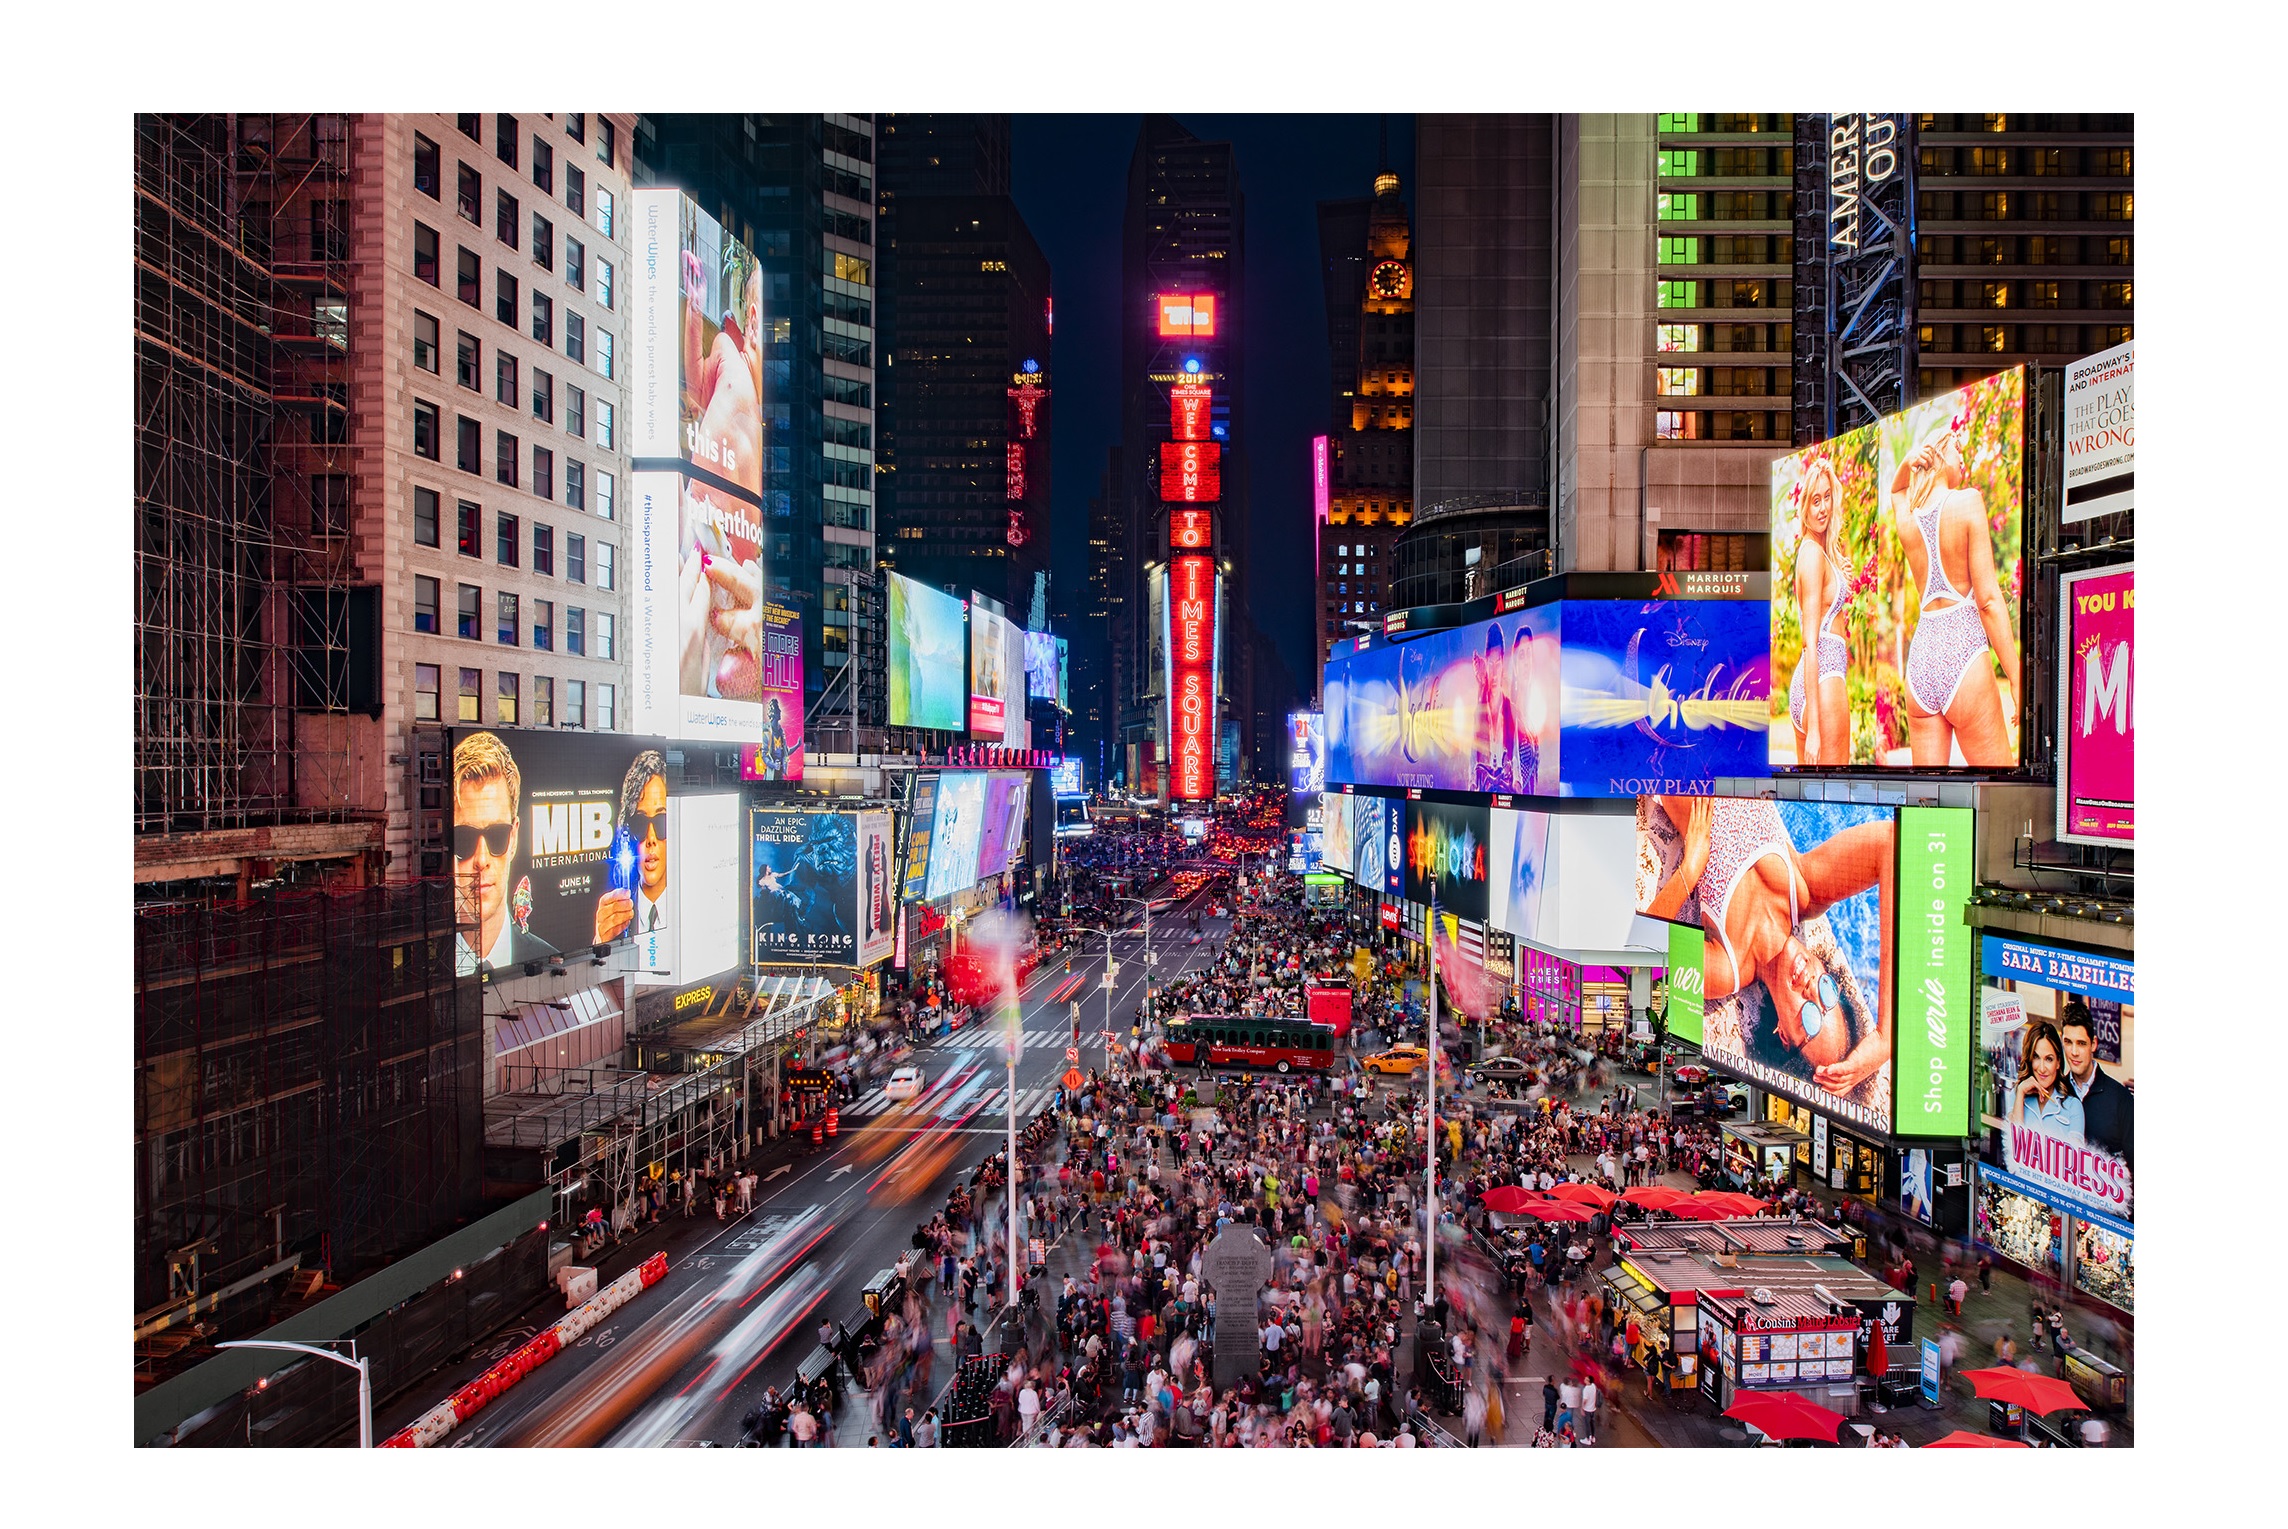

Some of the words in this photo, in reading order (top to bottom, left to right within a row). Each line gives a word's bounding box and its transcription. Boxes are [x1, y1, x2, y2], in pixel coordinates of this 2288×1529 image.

[2073, 353, 2131, 381] BROADWAY'S
[2069, 380, 2087, 394] AND
[2074, 402, 2095, 418] THE
[2097, 386, 2132, 412] PLAY
[2069, 417, 2096, 436] THAT
[686, 422, 719, 463] this
[722, 440, 737, 471] is
[1183, 399, 1199, 501] WELCOME
[1183, 511, 1199, 545] TO
[642, 494, 653, 592] #thisisparenthood
[1687, 574, 1749, 583] MARRIOTT
[1687, 584, 1741, 594] MARQUIS
[1182, 561, 1202, 660] TIMES
[2077, 591, 2116, 615] YOU
[768, 632, 799, 656] MORE
[1663, 630, 1710, 651] Disney
[763, 653, 799, 690] HILL
[1182, 675, 1201, 795] SQUARE
[947, 746, 984, 766] 1540
[1609, 778, 1660, 794] NOW
[1664, 779, 1715, 795] PLAY
[532, 802, 614, 857] MIB
[756, 834, 781, 842] THRILL
[761, 826, 797, 834] DAZZLING
[1928, 832, 1947, 853] 3!
[532, 850, 614, 869] INTERNATIONAL
[1408, 834, 1486, 883] SEPHORA
[559, 877, 581, 889] JUNE
[582, 875, 590, 884] 14
[1929, 862, 1945, 890] on
[759, 933, 798, 943] KING
[807, 934, 853, 945] KONG
[1927, 898, 1945, 967] inside
[647, 936, 656, 967] wipes
[2002, 942, 2029, 954] ORIGINAL
[2048, 950, 2056, 958] BY
[2002, 951, 2043, 974] SARA
[675, 985, 711, 1010] EXPRESS
[1919, 978, 1946, 1049] aerie
[2093, 1018, 2119, 1044] GGS
[1702, 1044, 1760, 1079] AMERICAN
[1763, 1065, 1801, 1095] EAGLE
[1803, 1085, 1889, 1132] OUTFITTERS
[1924, 1057, 1948, 1113] Shop
[2010, 1122, 2124, 1204] WAITRESS
[2044, 1175, 2081, 1199] BROADWAY
[2082, 1192, 2114, 1210] MUSICAL
[1757, 1318, 1796, 1329] Cousins
[1797, 1316, 1826, 1329] Maine
